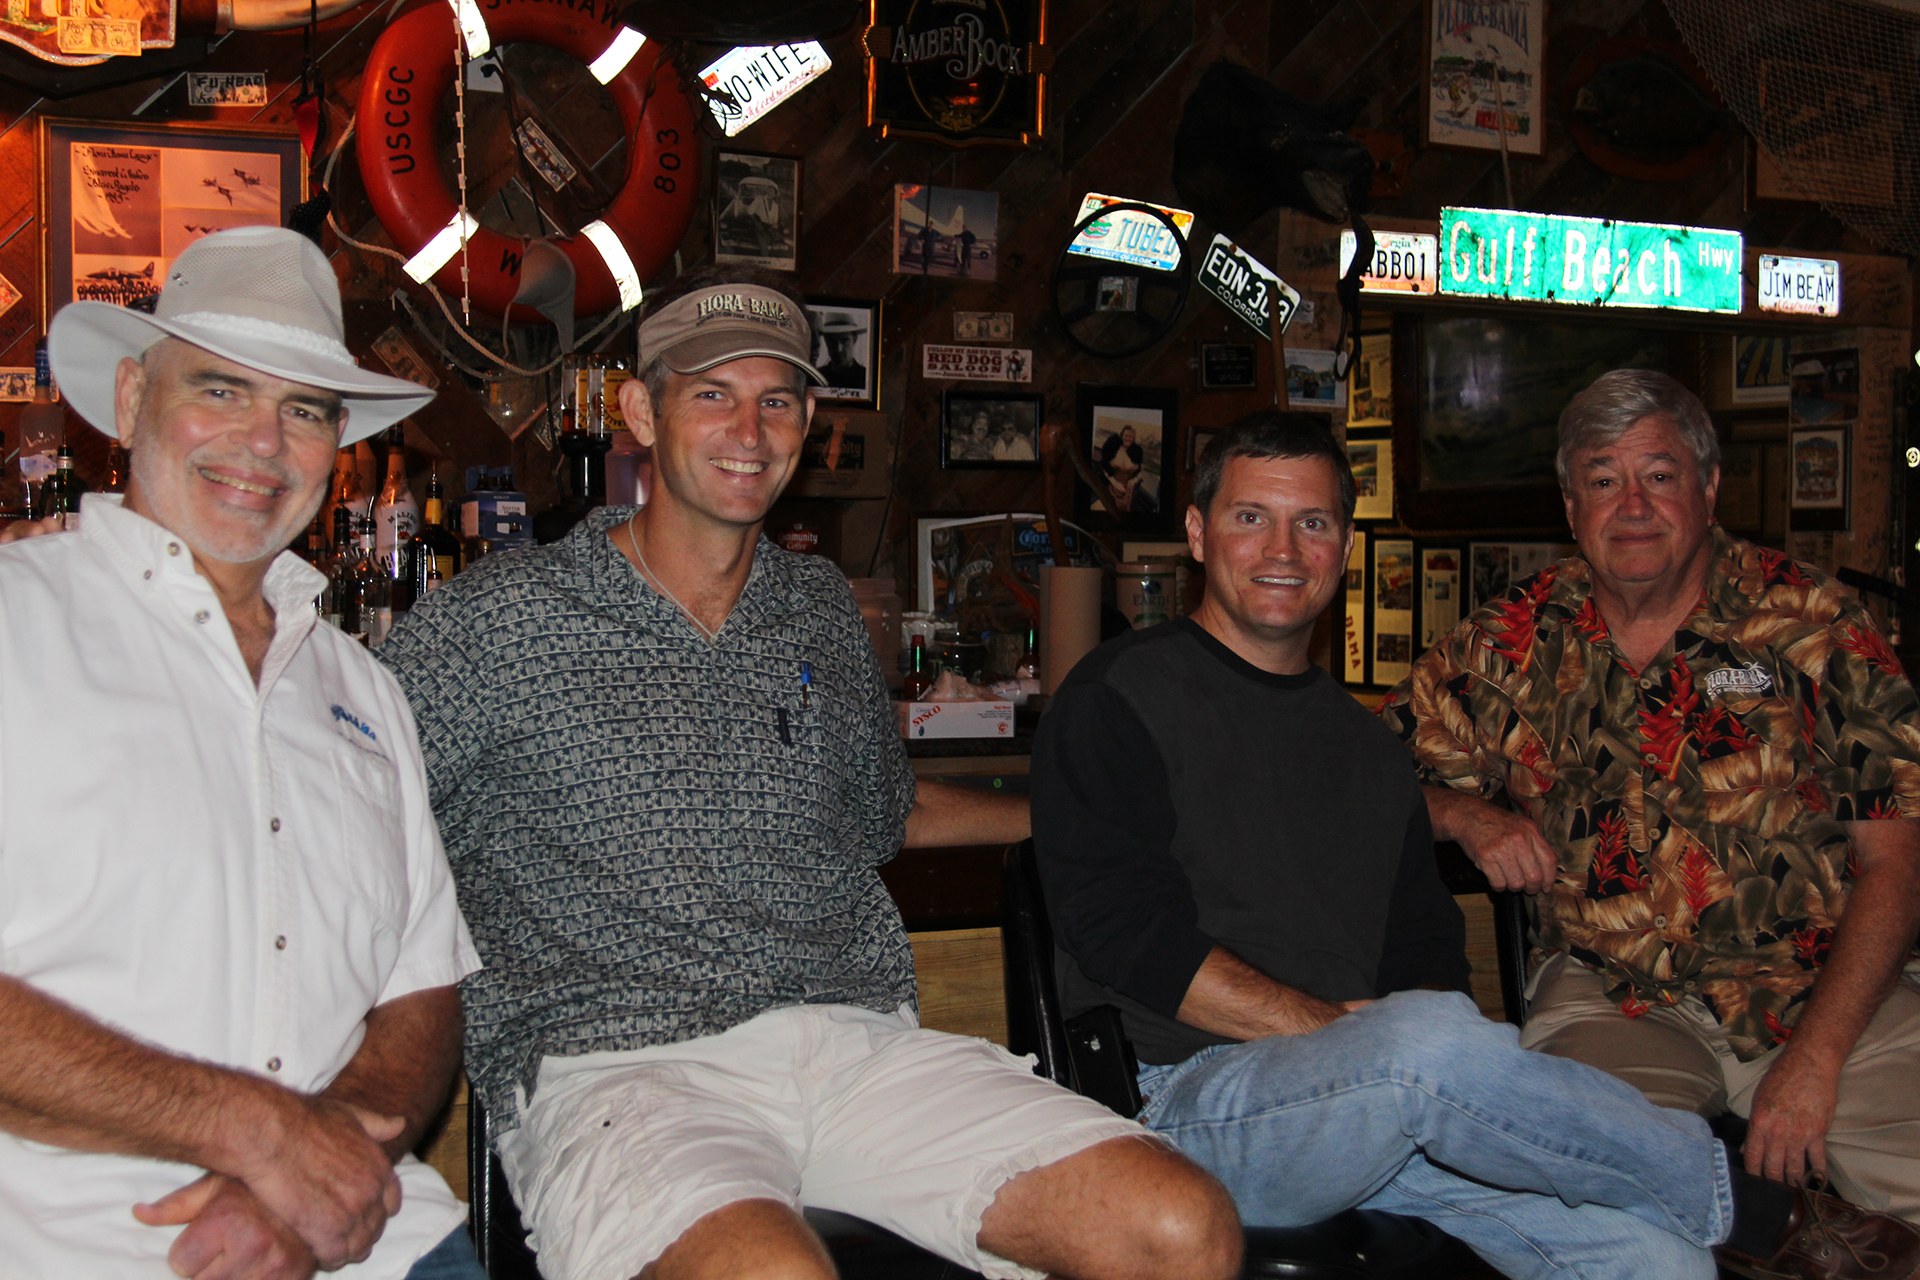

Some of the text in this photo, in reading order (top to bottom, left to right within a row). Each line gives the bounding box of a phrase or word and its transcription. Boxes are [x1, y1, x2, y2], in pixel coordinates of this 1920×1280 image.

[385, 65, 415, 175] USCGC
[653, 128, 681, 194] 803
[1080, 246, 1119, 259] UIVERSITY
[1131, 255, 1161, 266] FLORIA
[1451, 220, 1734, 298] Gulf Beach Hwy
[1764, 271, 1834, 303] JIM BEAM
[1217, 285, 1264, 326] COLORADO
[927, 353, 1002, 366] RED DOG
[927, 363, 1001, 373] SALOON
[912, 705, 941, 727] SYSCO
